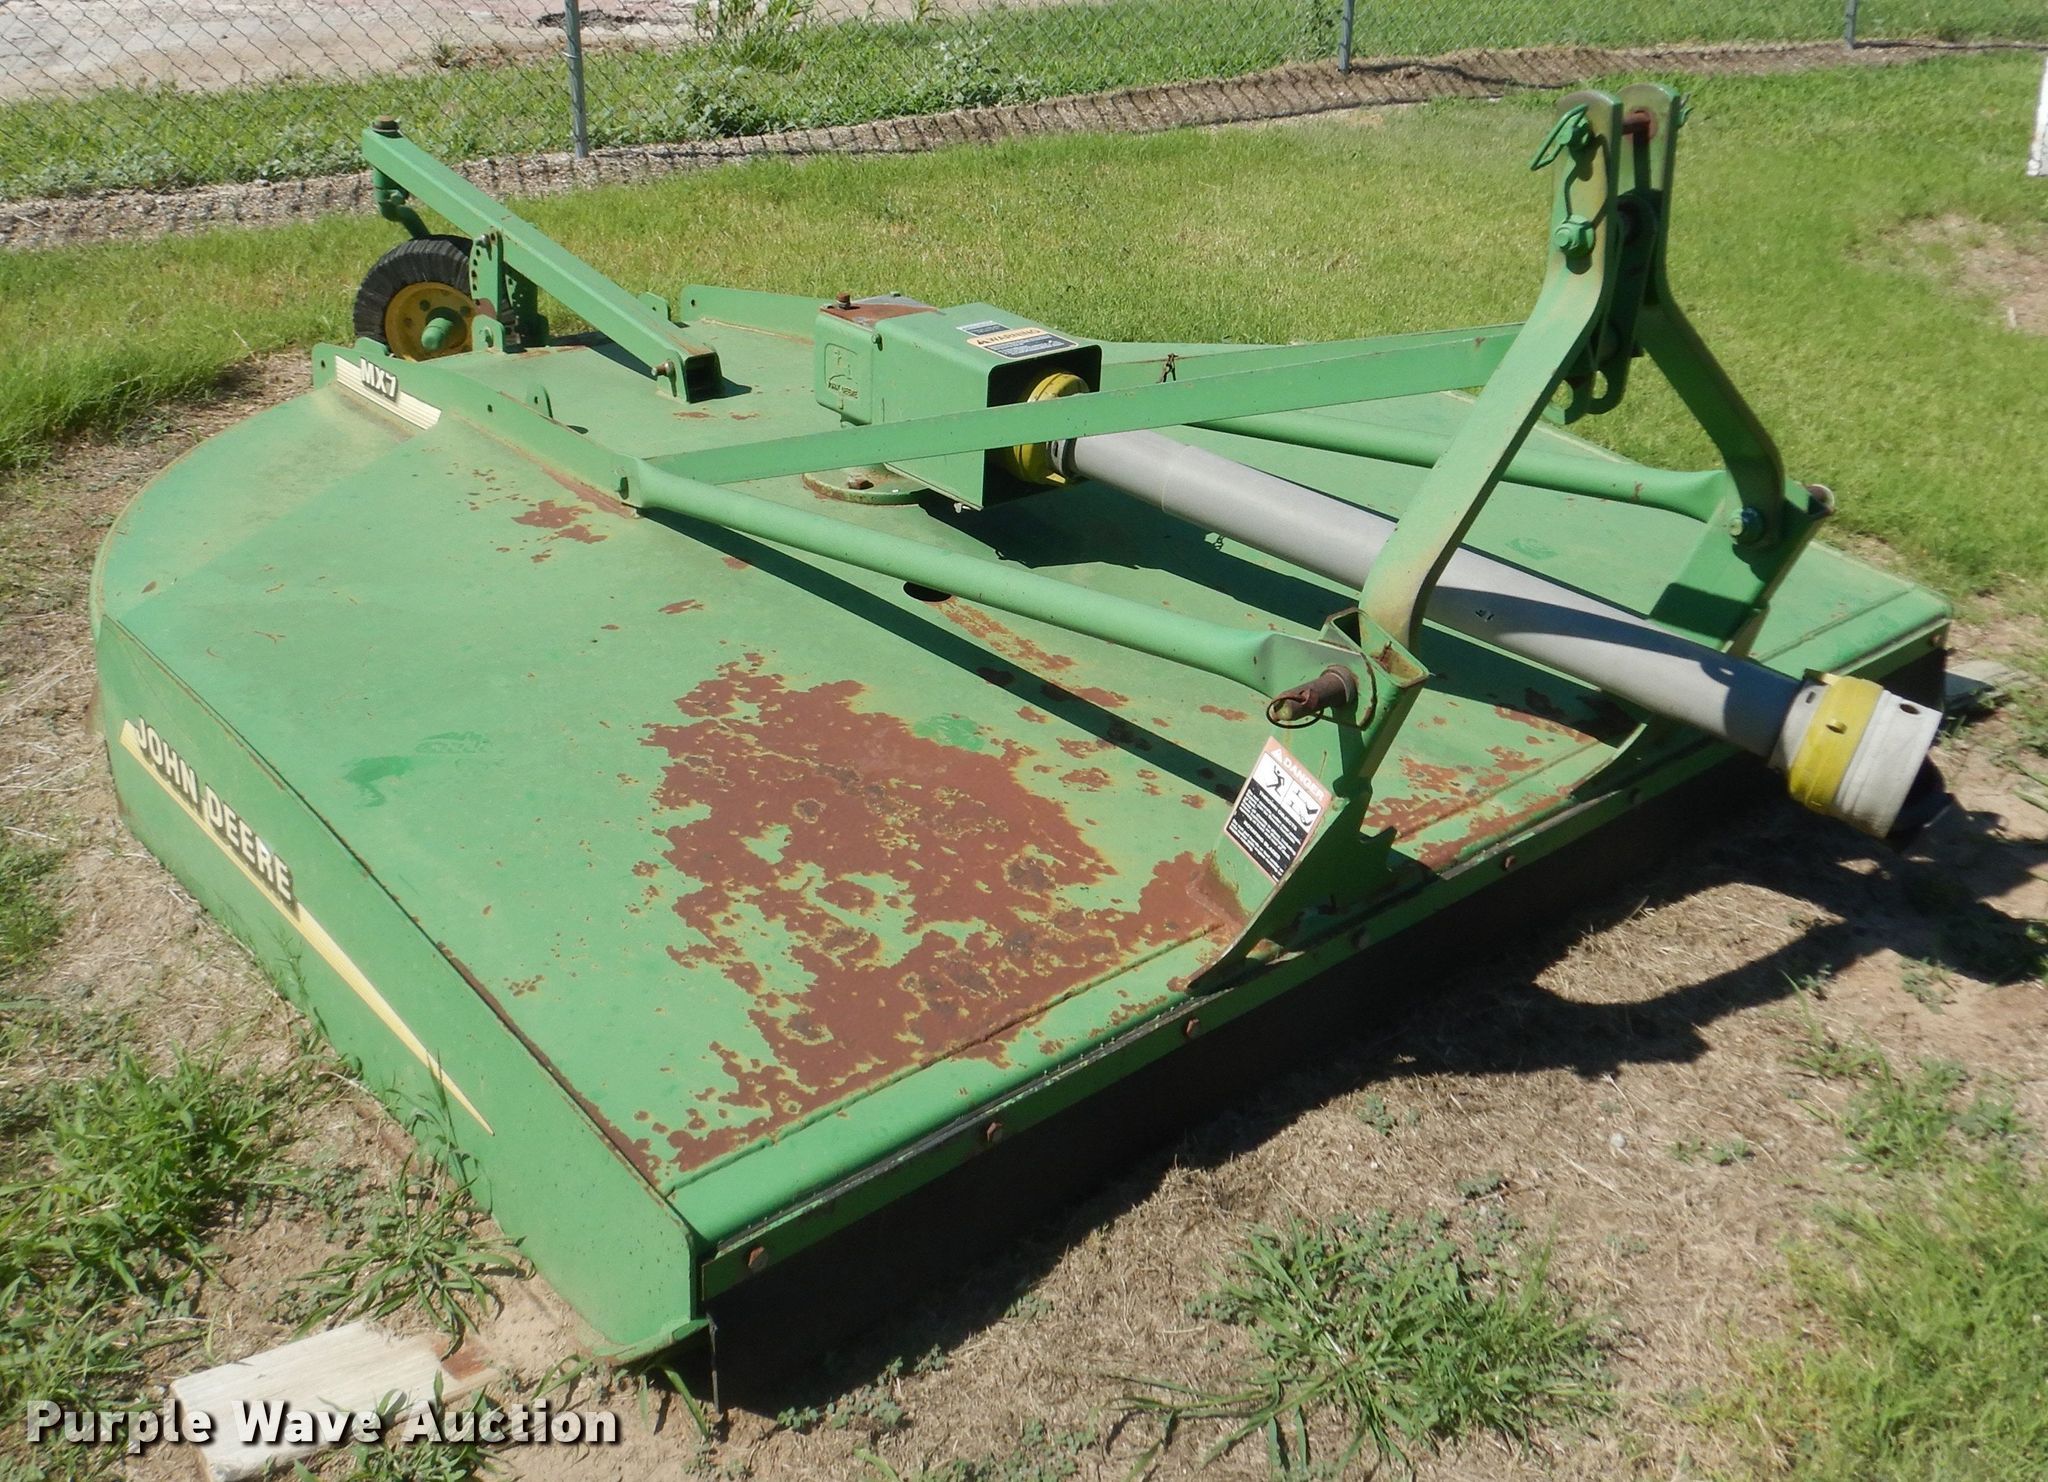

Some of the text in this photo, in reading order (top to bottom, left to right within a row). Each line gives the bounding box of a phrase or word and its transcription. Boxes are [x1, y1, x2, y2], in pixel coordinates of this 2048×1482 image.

[360, 357, 397, 400] MX7
[1283, 757, 1325, 801] DANGER
[134, 716, 293, 902] JOHN DEERE
